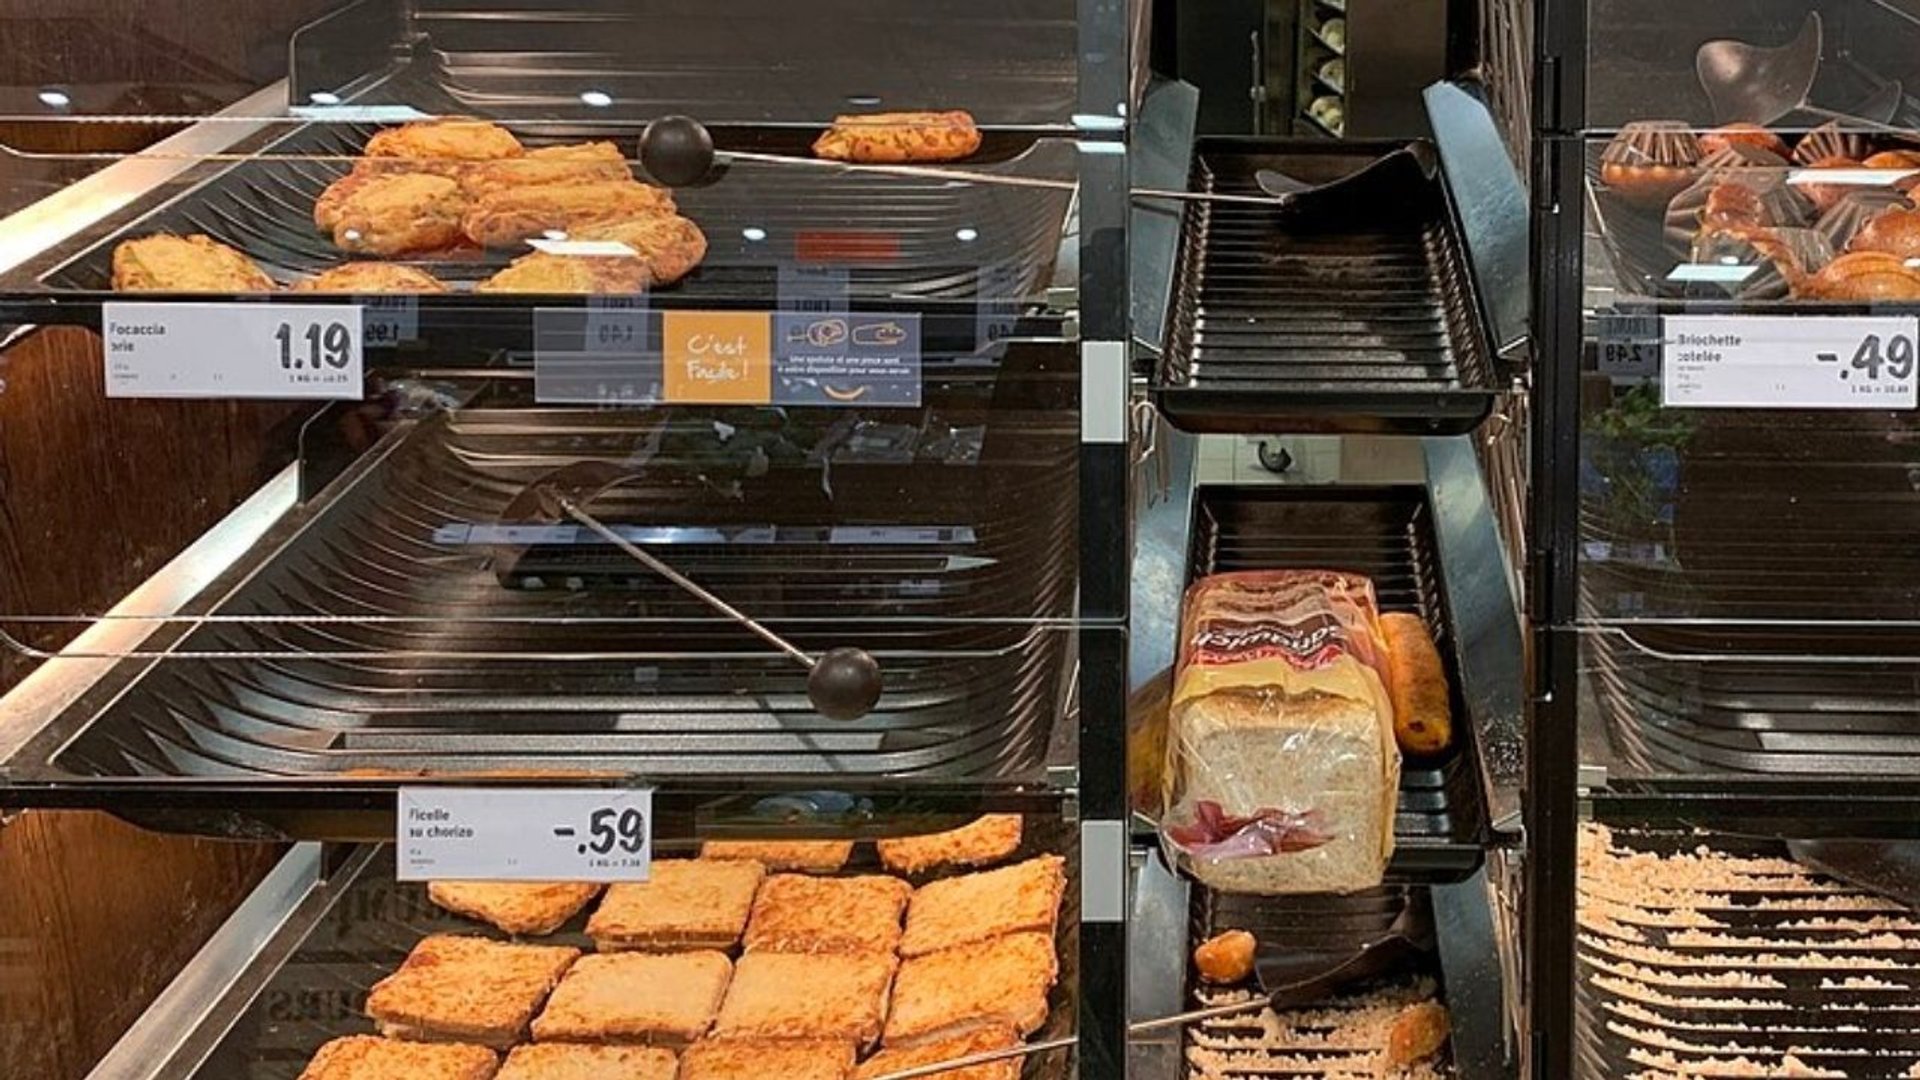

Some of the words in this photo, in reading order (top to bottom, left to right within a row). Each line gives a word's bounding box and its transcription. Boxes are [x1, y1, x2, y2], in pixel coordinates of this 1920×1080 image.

[275, 321, 351, 370] 1.19
[686, 333, 747, 355] C'est
[1678, 333, 1742, 347] Briochette
[1816, 333, 1914, 380] -.49
[427, 825, 474, 838] chorizo
[554, 807, 645, 854] -.59
